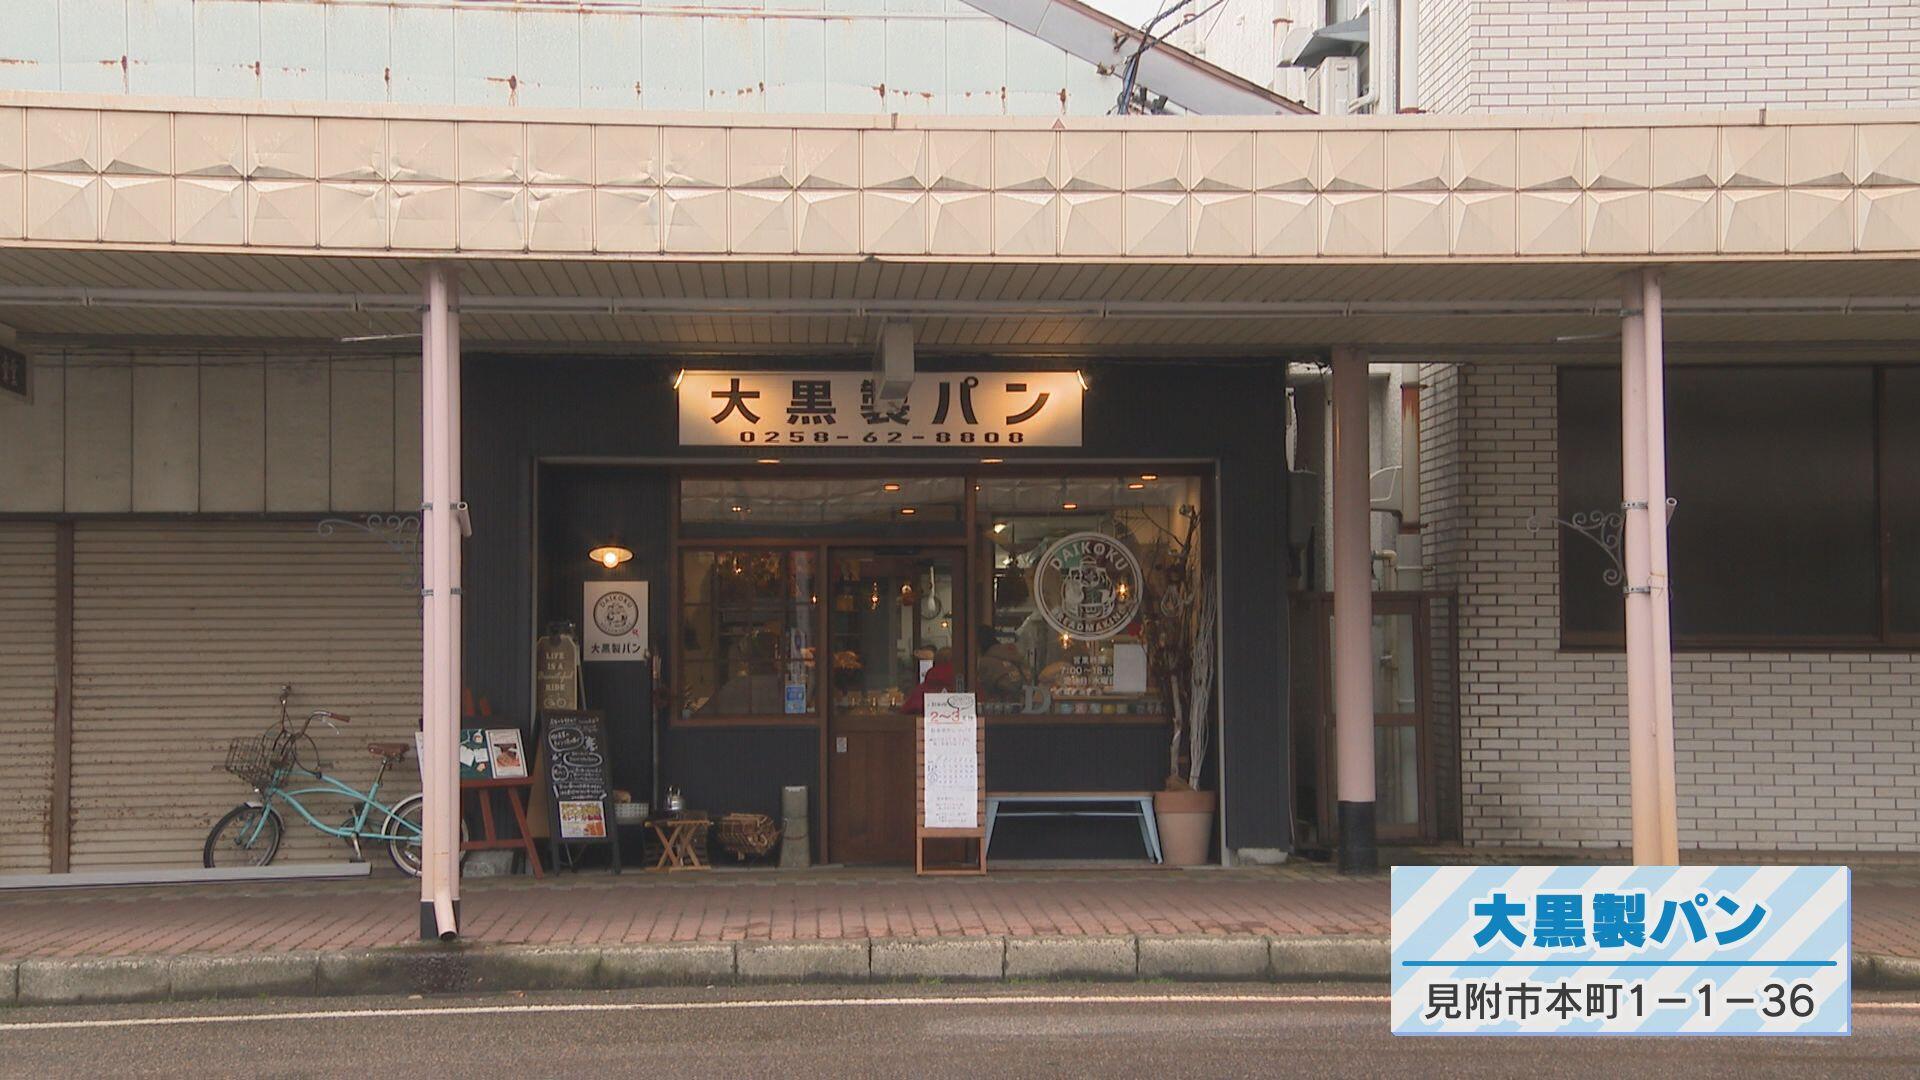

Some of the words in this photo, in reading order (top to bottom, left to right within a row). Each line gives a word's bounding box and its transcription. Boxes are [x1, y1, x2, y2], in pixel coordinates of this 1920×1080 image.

[710, 374, 1051, 425] 大黒製パン
[739, 431, 1025, 444] 0258-62-8808
[1050, 540, 1129, 572] DAIKOKU
[591, 642, 641, 655] 大黒製パン
[545, 652, 565, 660] LIFE
